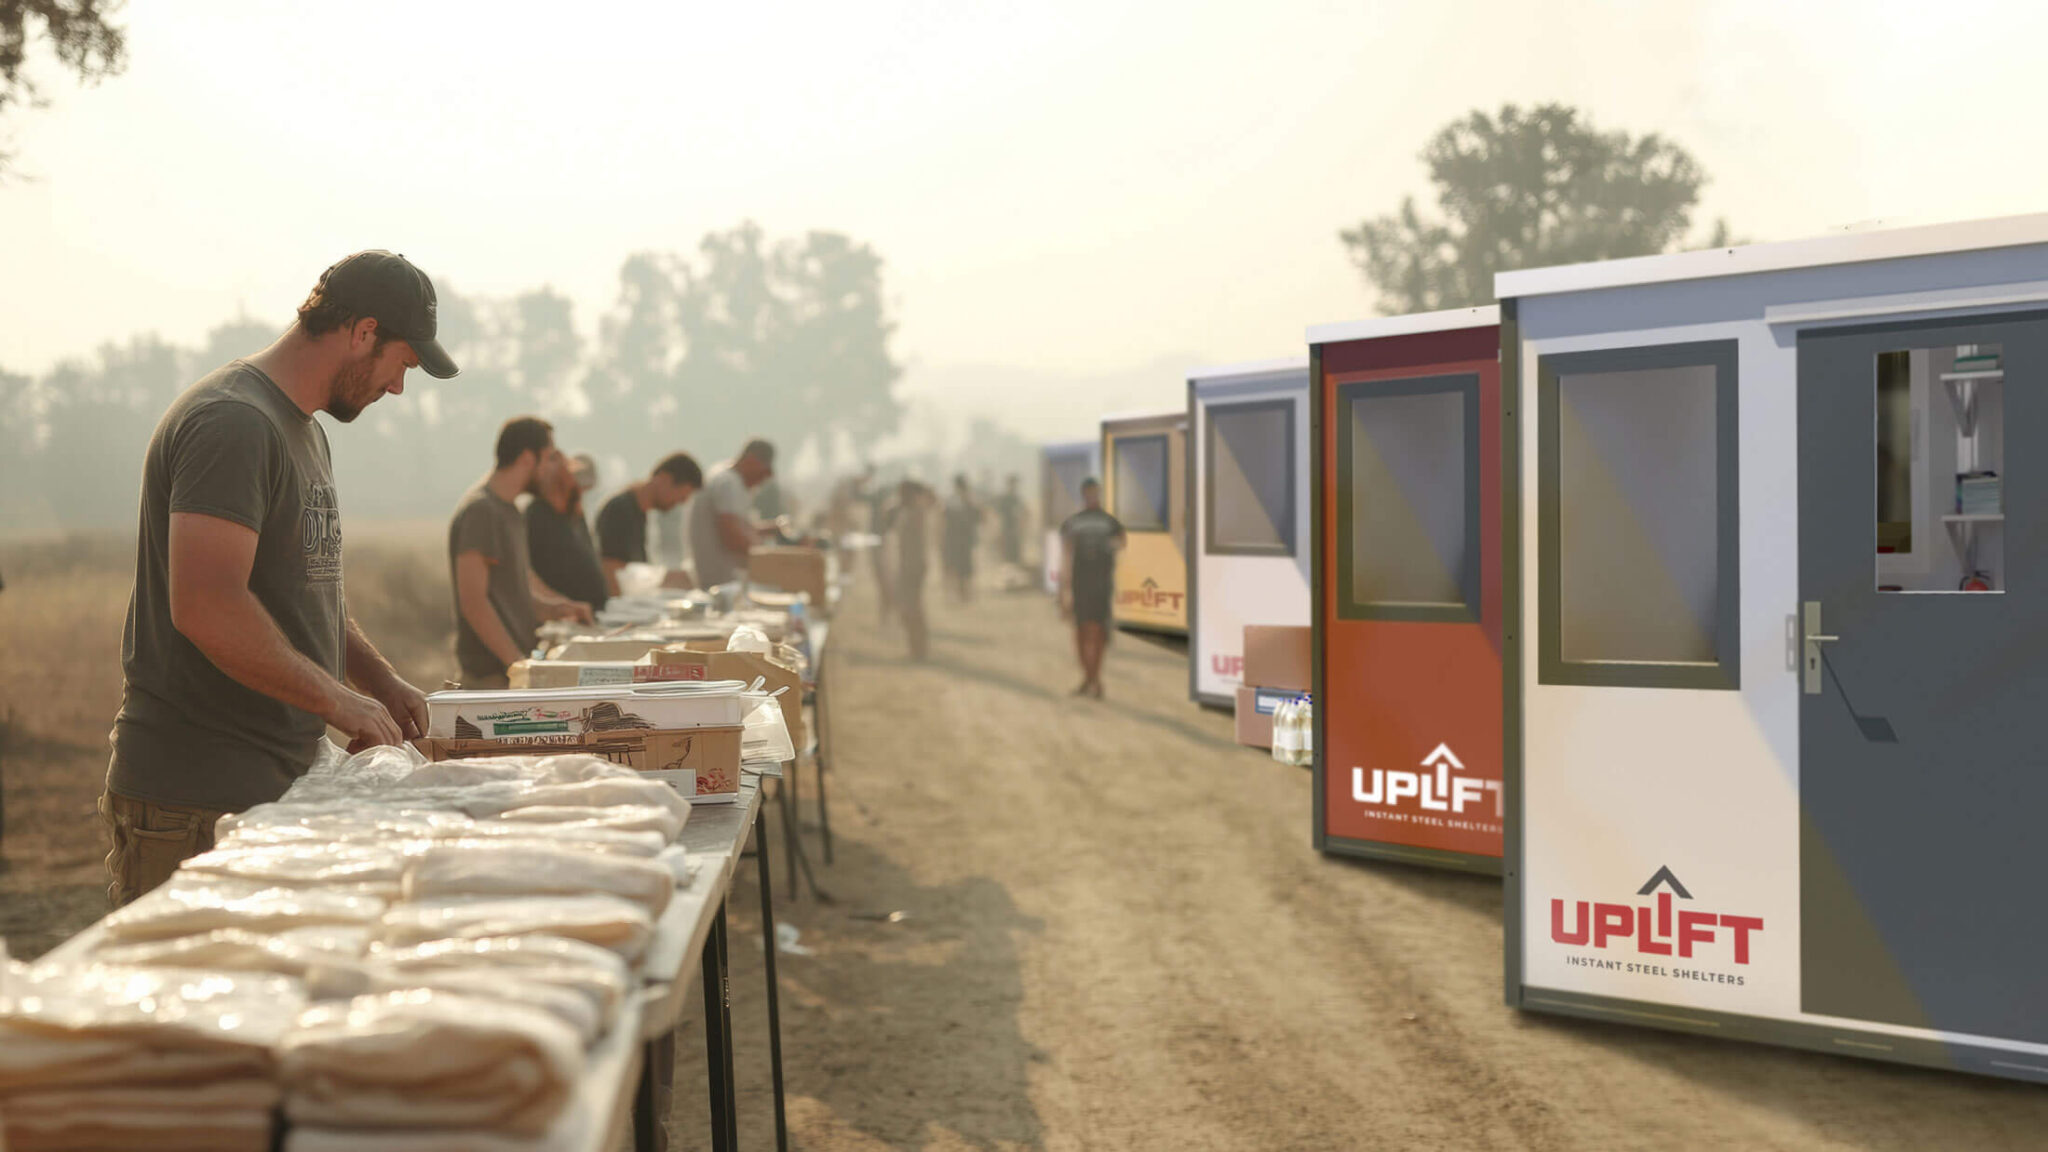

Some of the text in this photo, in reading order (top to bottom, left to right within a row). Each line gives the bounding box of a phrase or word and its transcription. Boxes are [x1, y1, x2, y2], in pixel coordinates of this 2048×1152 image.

[1364, 810, 1409, 822] INSTANT
[1411, 815, 1444, 827] STEEL
[1551, 892, 1764, 965] UPLIFT
[1566, 955, 1745, 986] INSTANT STEEL SHELTERS
